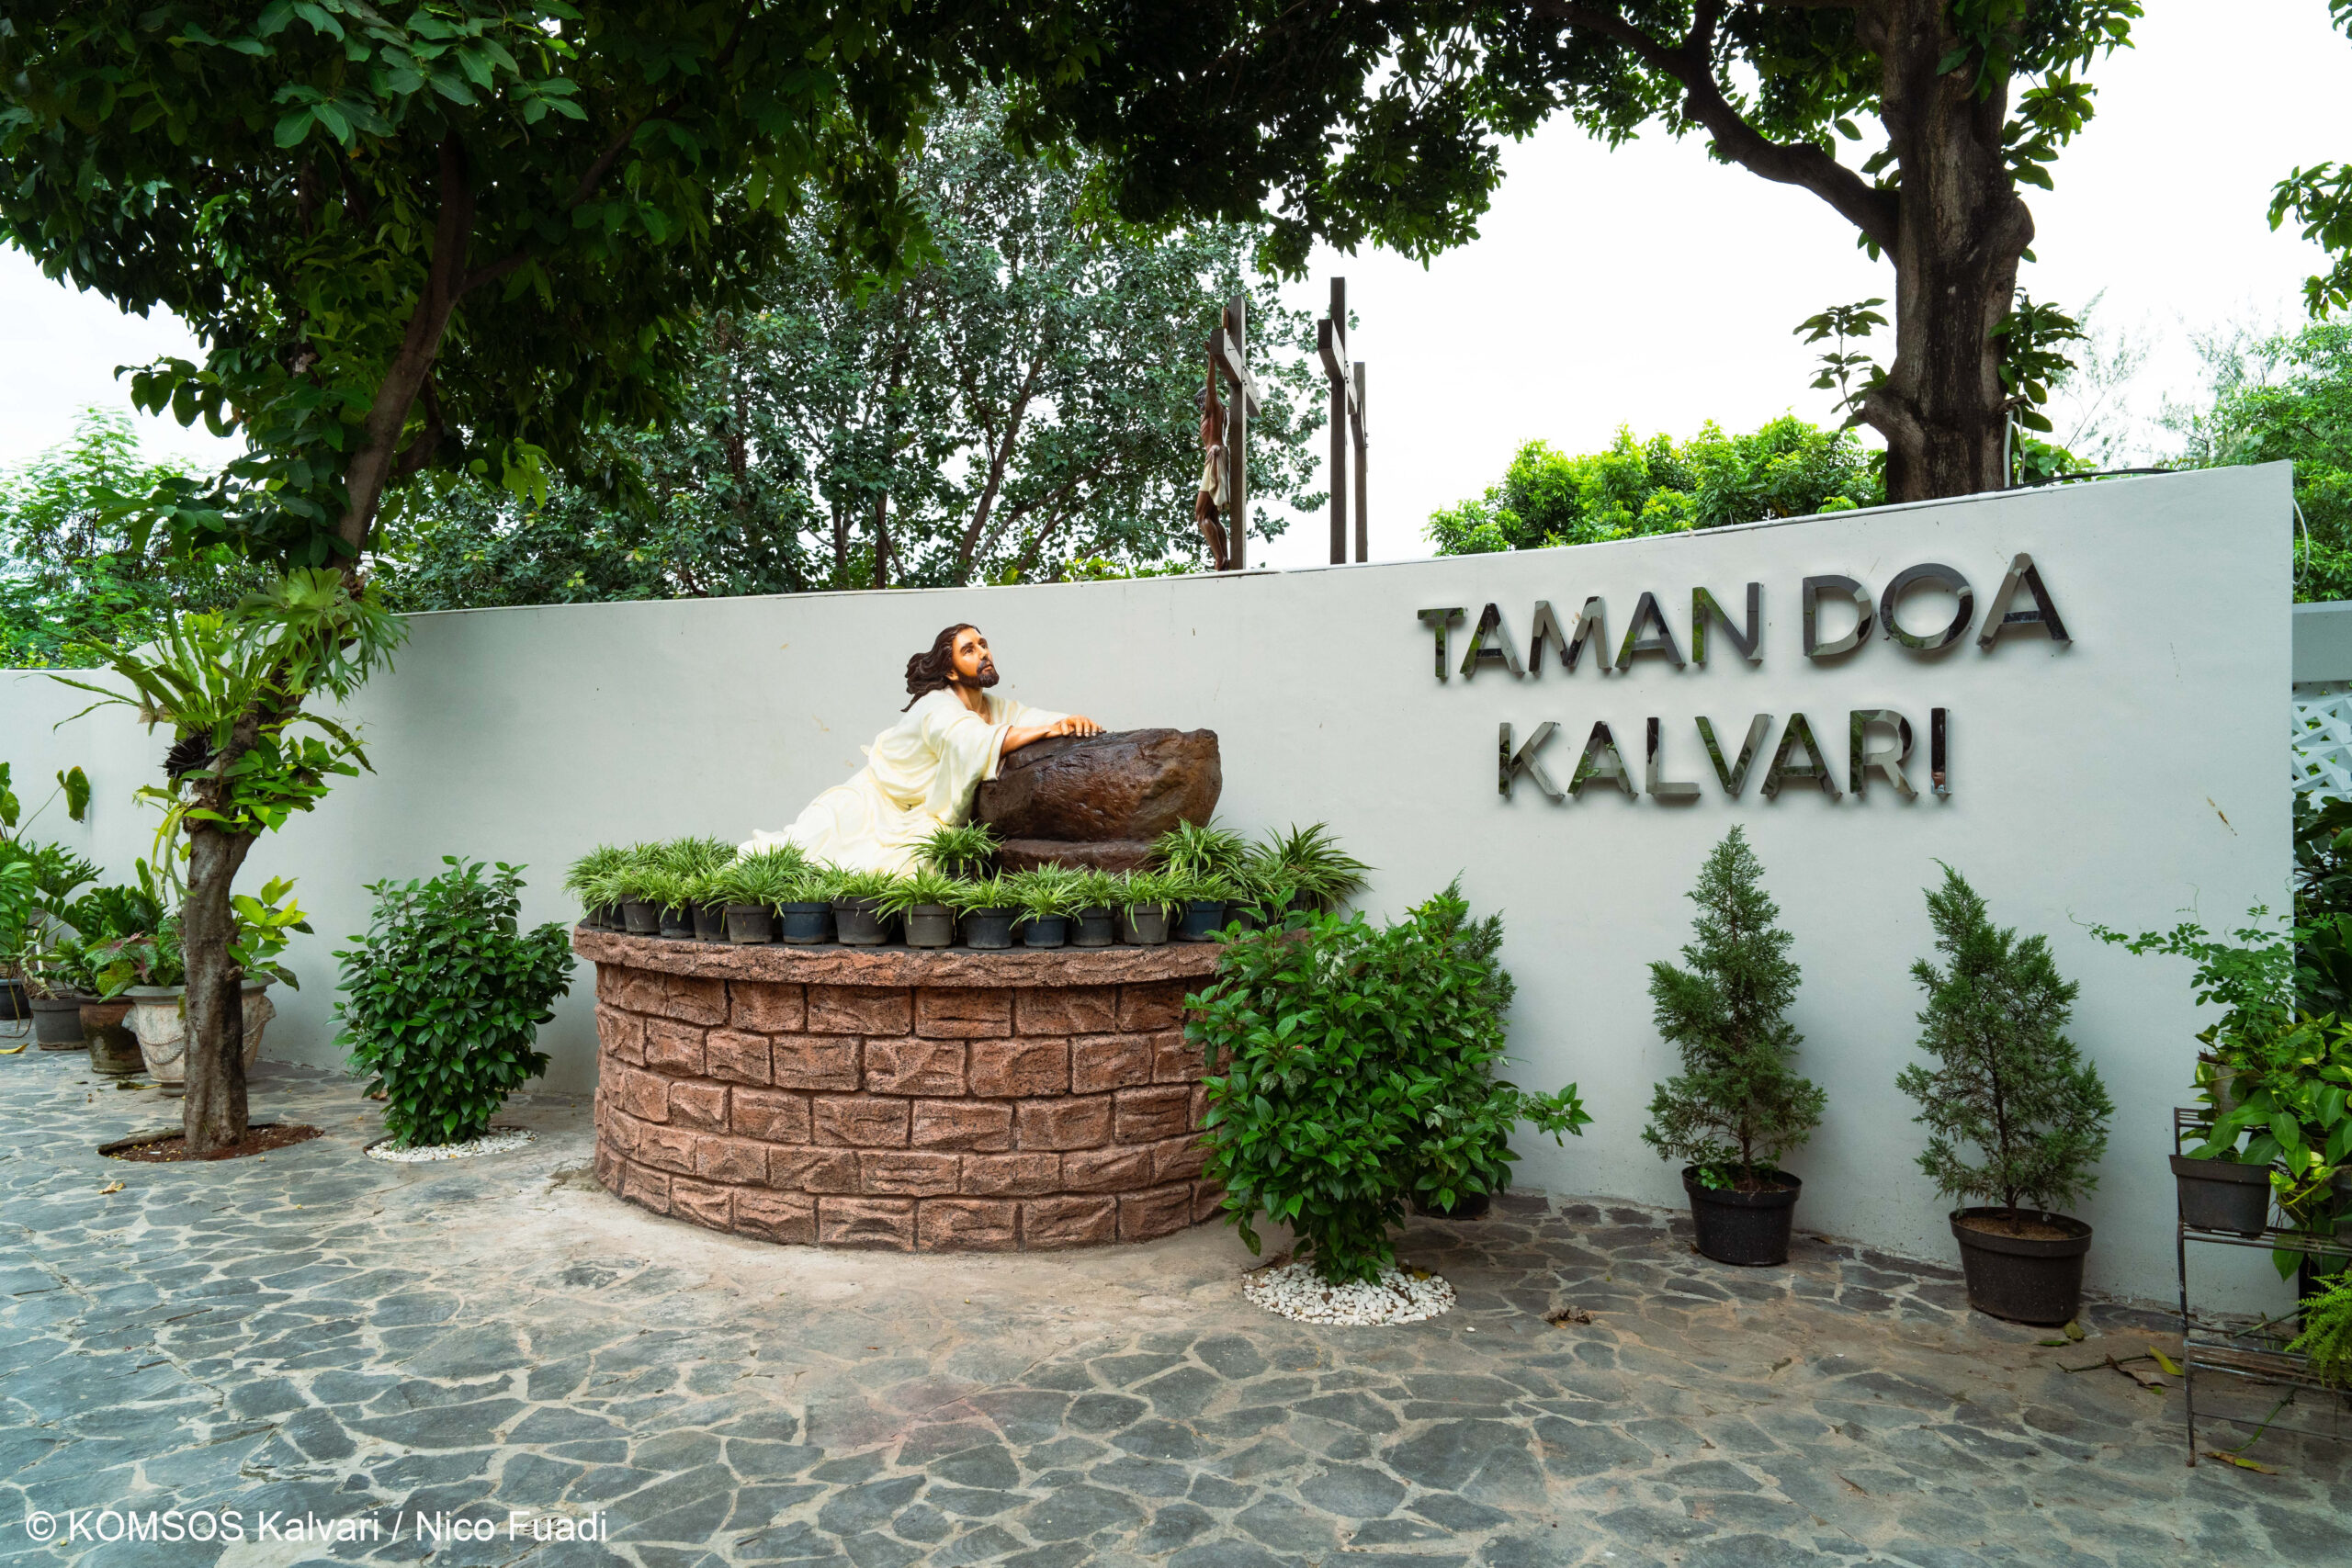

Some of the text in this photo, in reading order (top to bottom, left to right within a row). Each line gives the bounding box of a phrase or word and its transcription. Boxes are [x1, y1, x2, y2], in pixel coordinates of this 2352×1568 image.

[1417, 552, 2074, 680] TAMAN DOA
[1498, 706, 1952, 797] KALVARI
